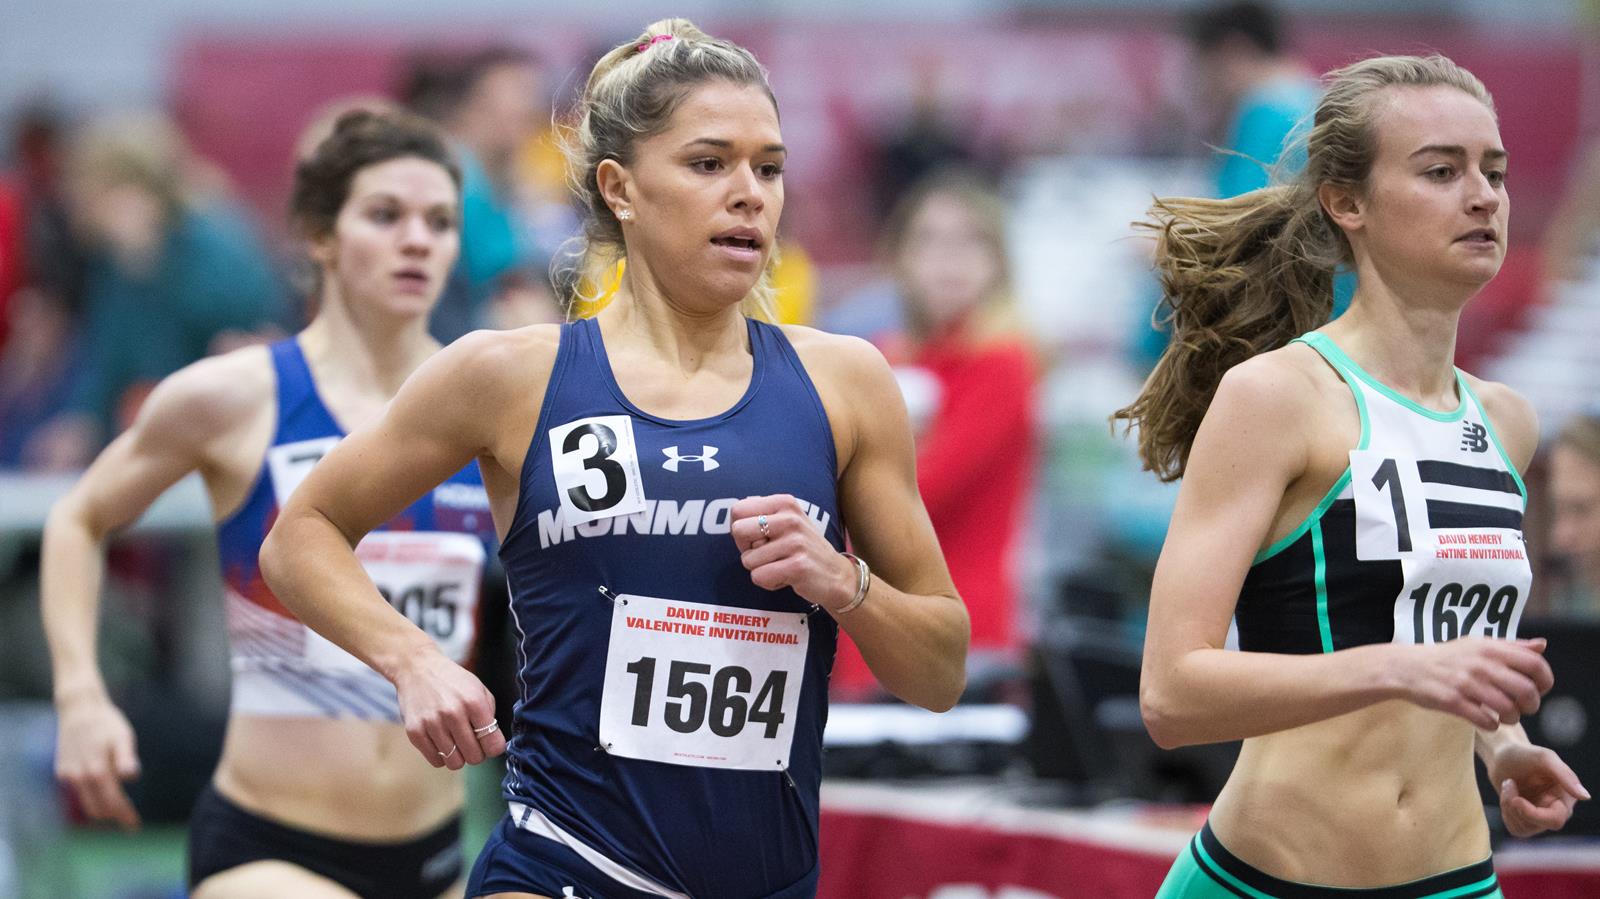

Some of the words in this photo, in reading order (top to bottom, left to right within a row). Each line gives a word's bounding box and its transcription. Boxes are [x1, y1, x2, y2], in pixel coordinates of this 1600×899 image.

[562, 423, 627, 512] 3
[537, 497, 830, 549] MNMOH
[1371, 458, 1413, 552] 1
[1436, 548, 1468, 559] ENTINE
[1469, 548, 1525, 560] INVITATIONAL
[1438, 534, 1467, 545] DAVID
[1468, 534, 1503, 545] HEMERY
[626, 616, 705, 637] VALENTINE
[708, 625, 799, 645] INVITATIONAL
[666, 606, 710, 621] DAVID
[713, 611, 771, 628] HEMERY
[1409, 582, 1519, 645] 1629
[626, 656, 788, 739] 1564
